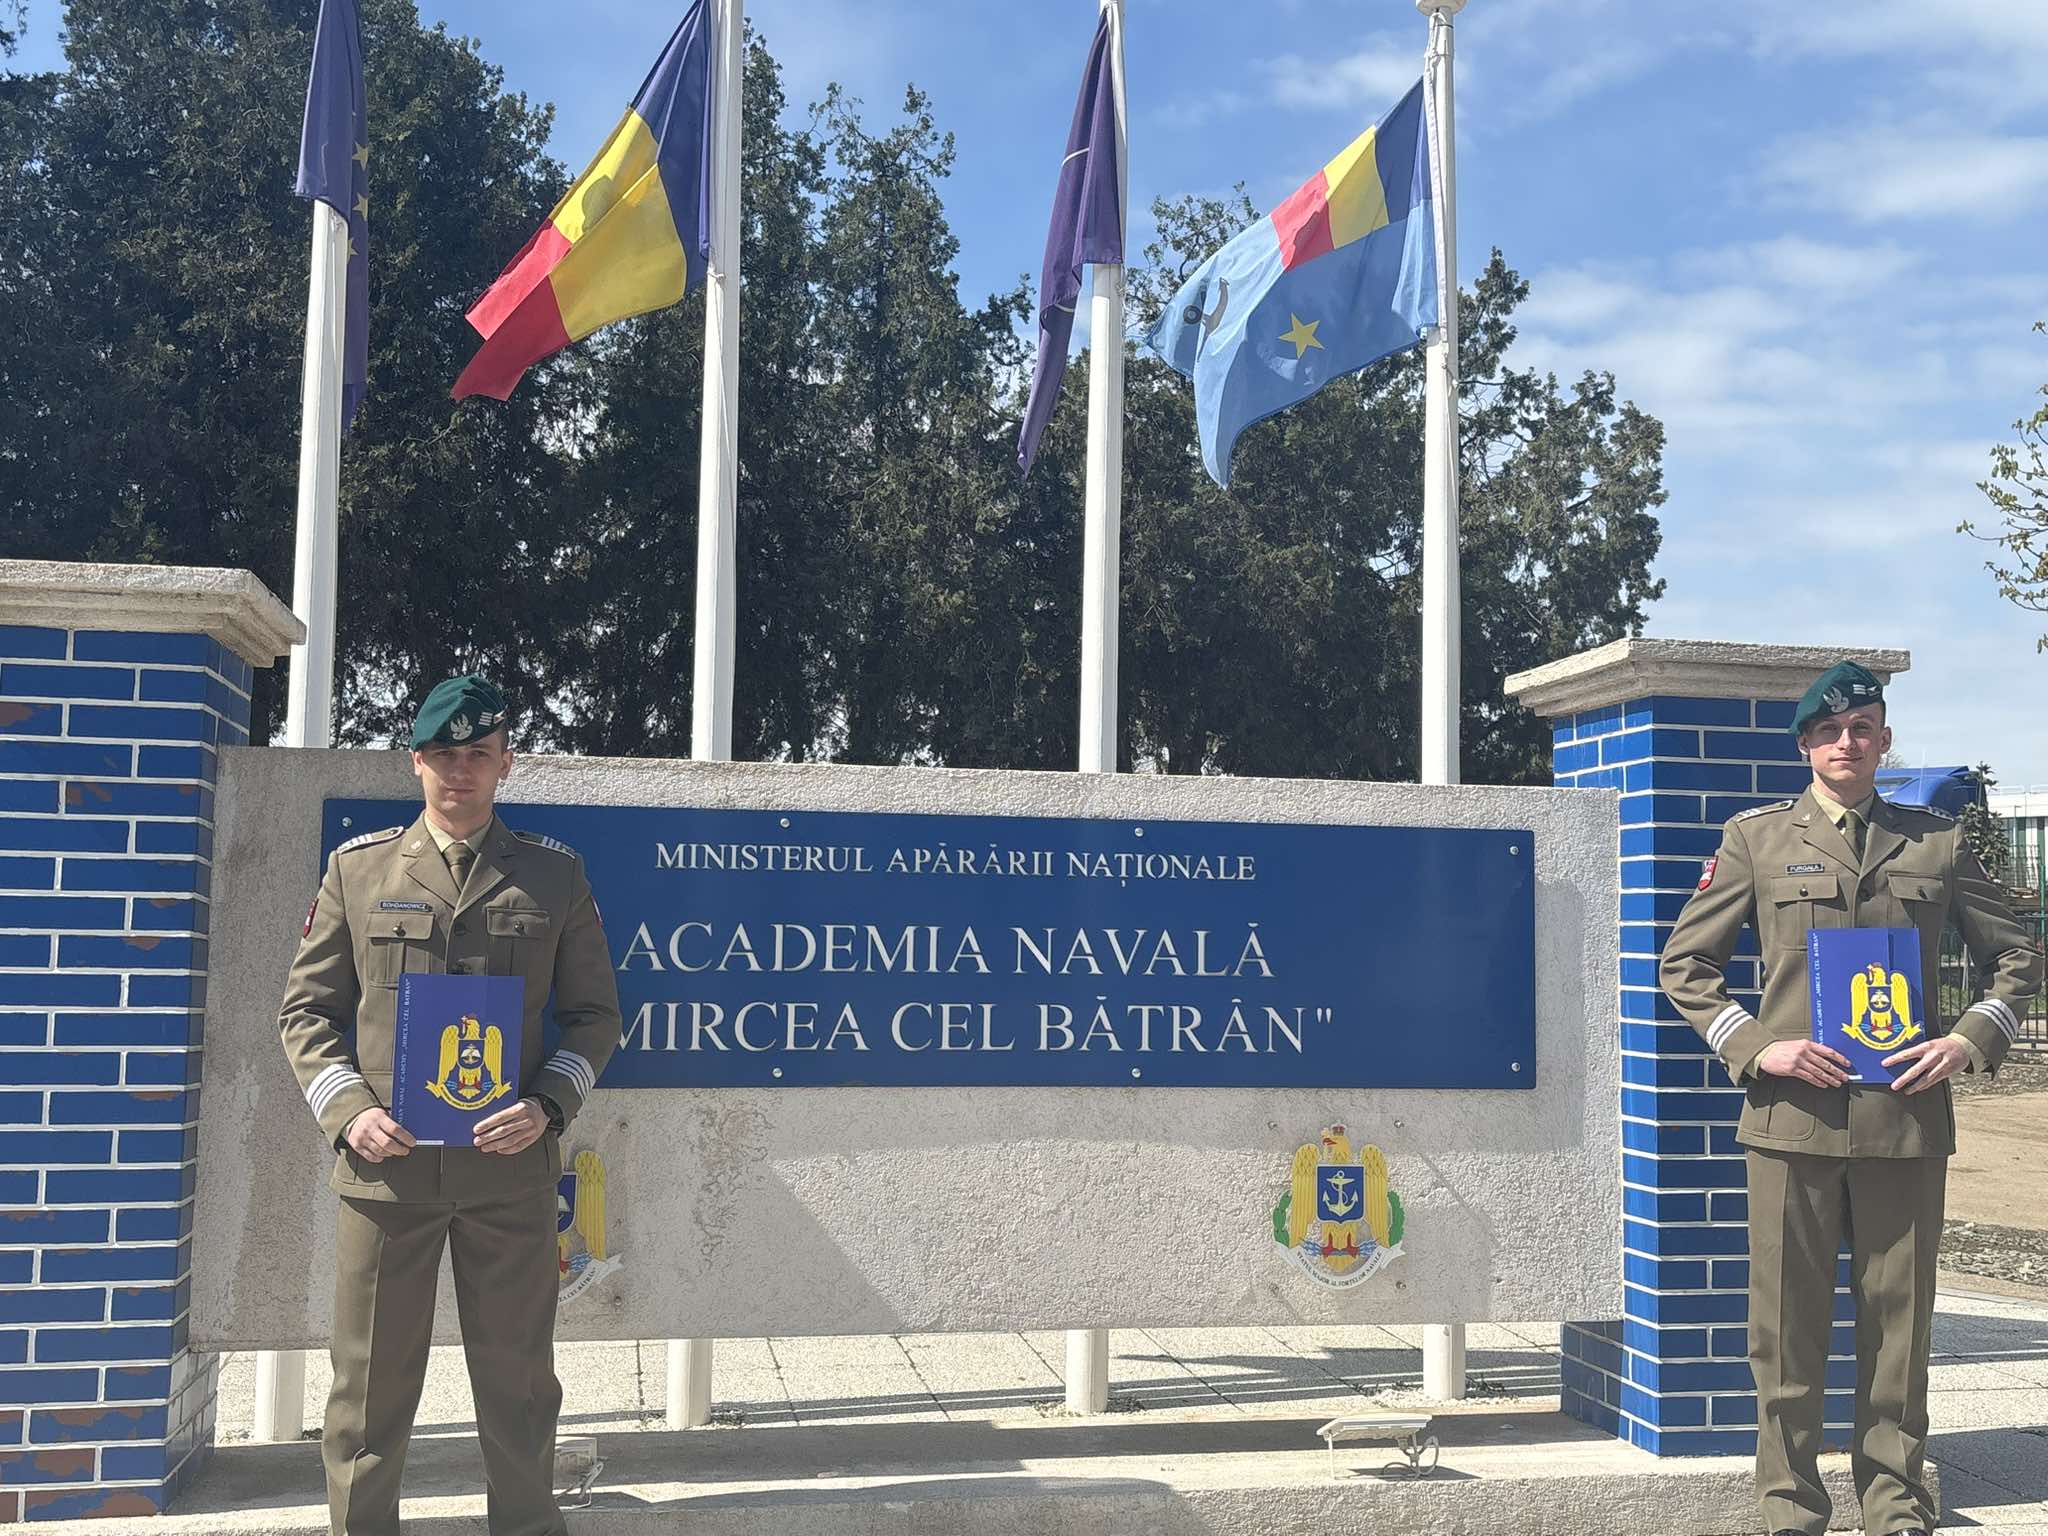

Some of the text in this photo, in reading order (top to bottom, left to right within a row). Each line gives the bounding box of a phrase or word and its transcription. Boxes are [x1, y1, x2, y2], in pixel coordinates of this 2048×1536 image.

[655, 842, 1256, 887] MINISTERUL APĂRĂRII NAȚIONALE
[617, 921, 1277, 978] ACADEMIA NAVALĂ
[891, 1002, 1015, 1052] CEL
